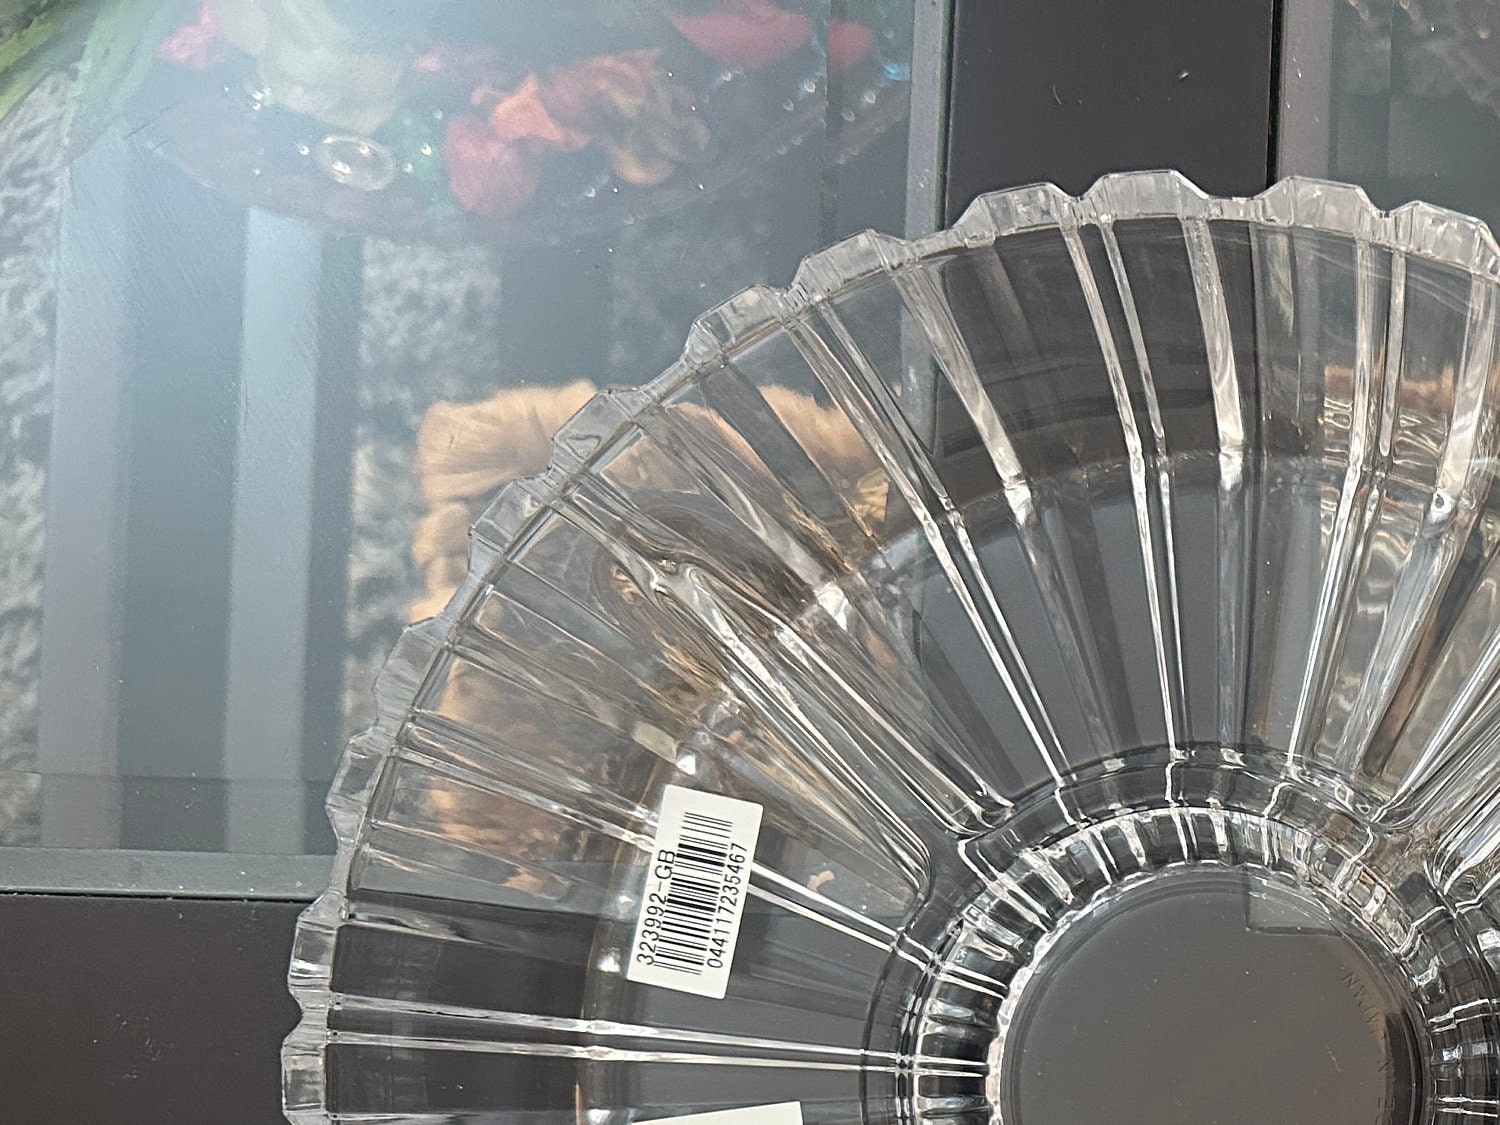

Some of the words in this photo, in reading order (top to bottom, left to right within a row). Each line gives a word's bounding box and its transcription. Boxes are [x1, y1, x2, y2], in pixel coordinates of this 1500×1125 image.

[636, 849, 676, 965] 323992-GB
[706, 843, 747, 969] 044117235467
[1341, 972, 1386, 1039] JAPAN
